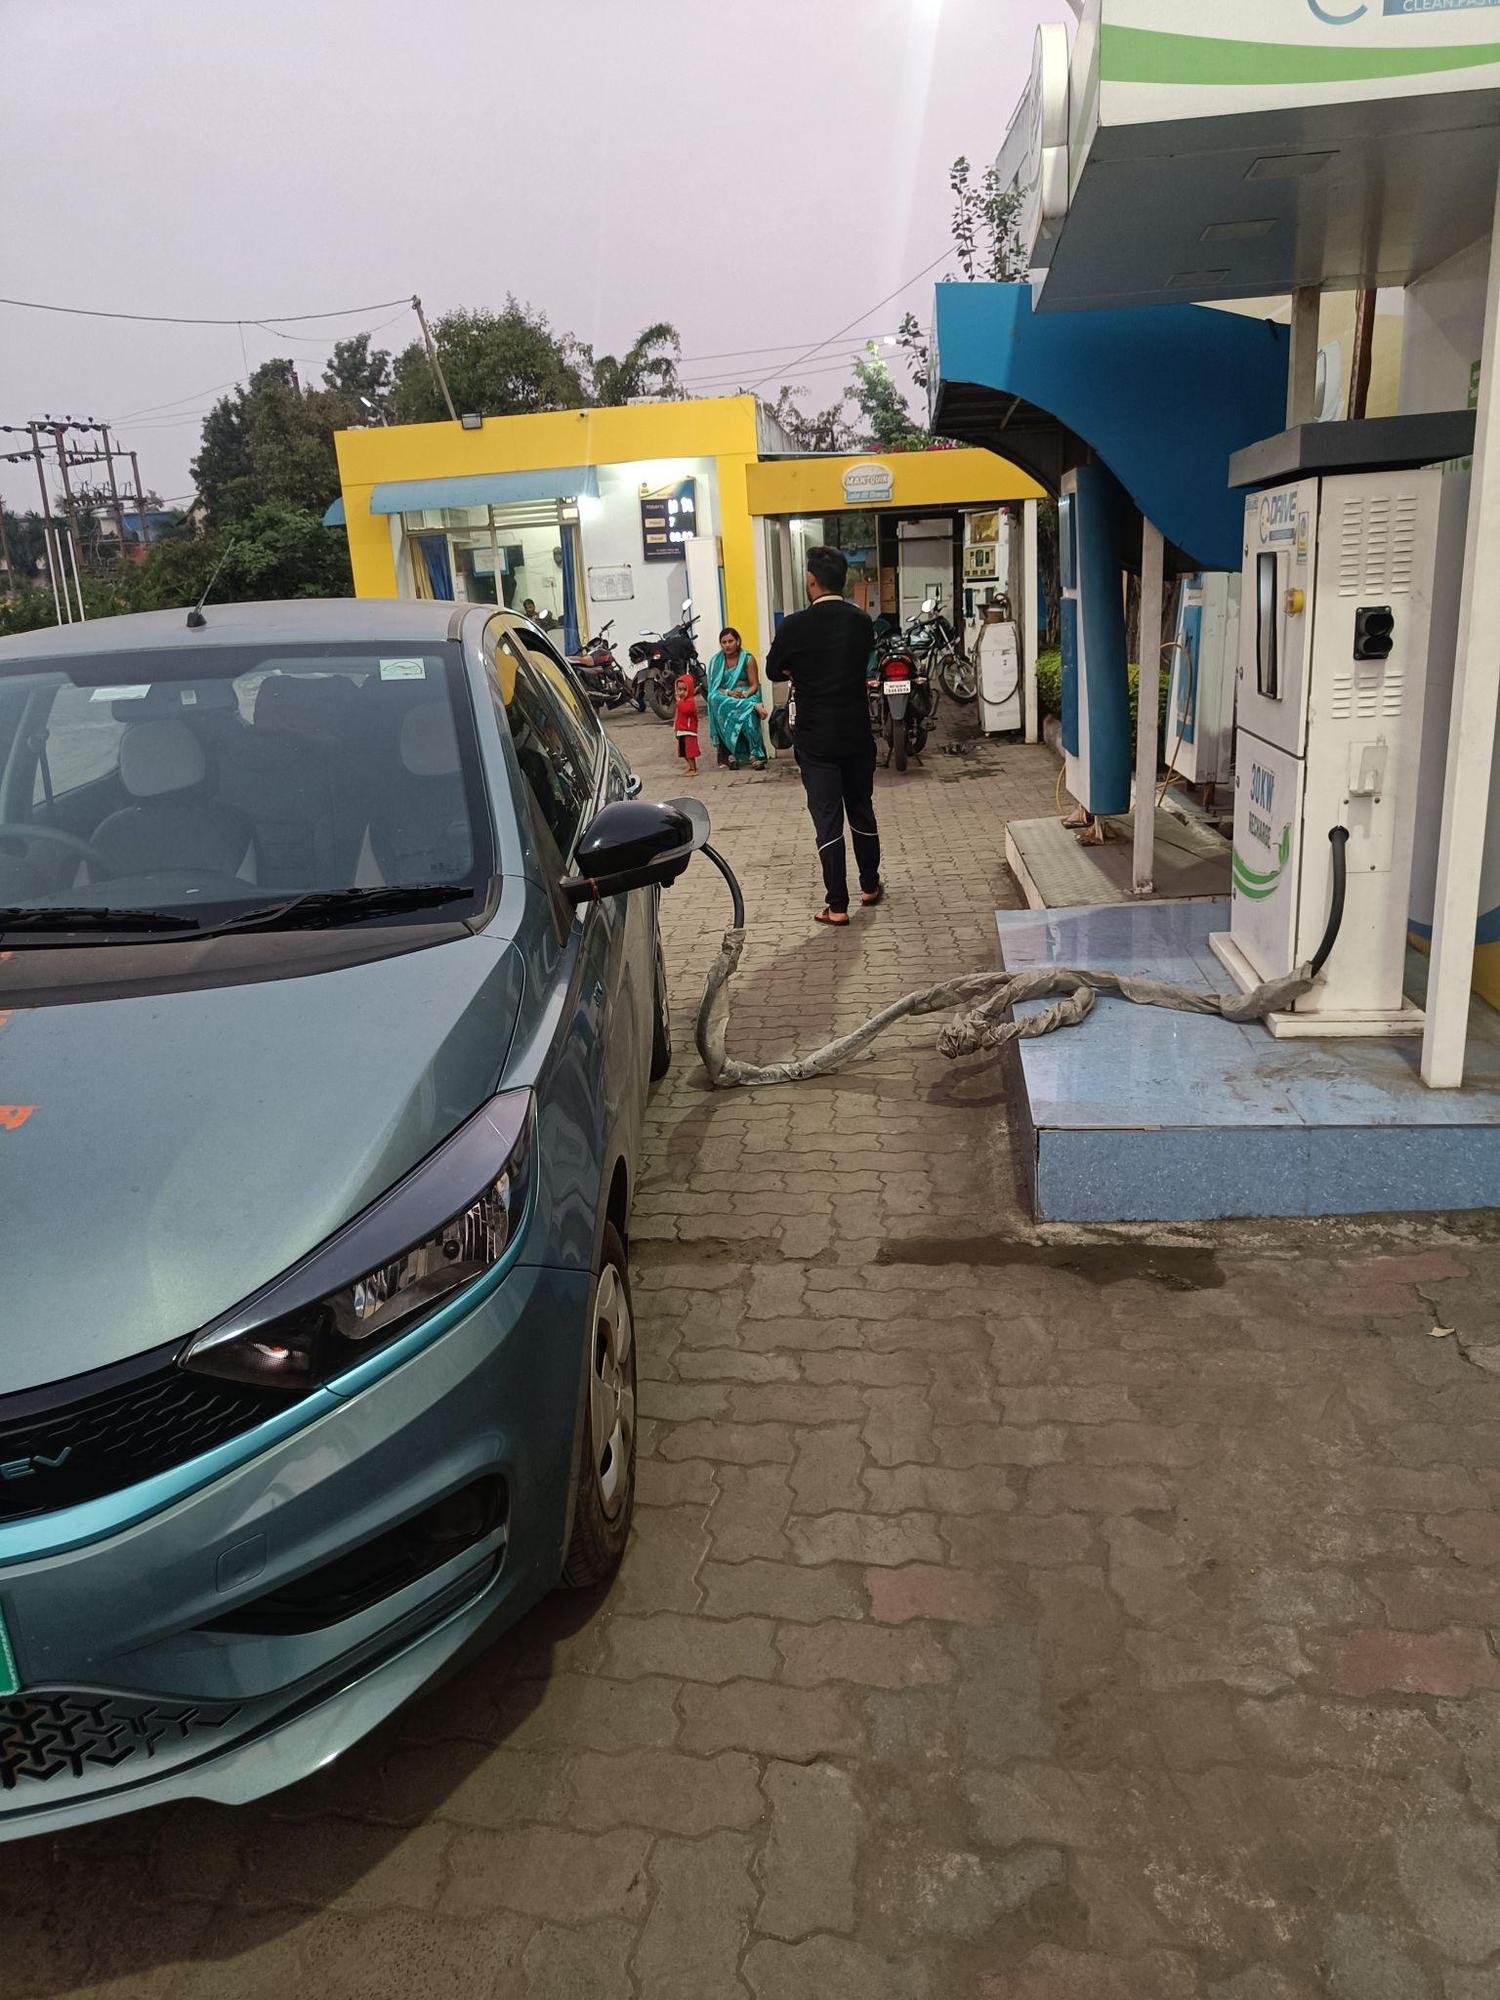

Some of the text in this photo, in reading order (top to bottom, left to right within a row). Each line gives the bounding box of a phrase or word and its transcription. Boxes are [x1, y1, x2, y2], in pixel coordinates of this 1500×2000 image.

[1269, 491, 1298, 526] DRIVE
[1250, 762, 1275, 814] 30KW
[1248, 810, 1272, 849] RECHARGE
